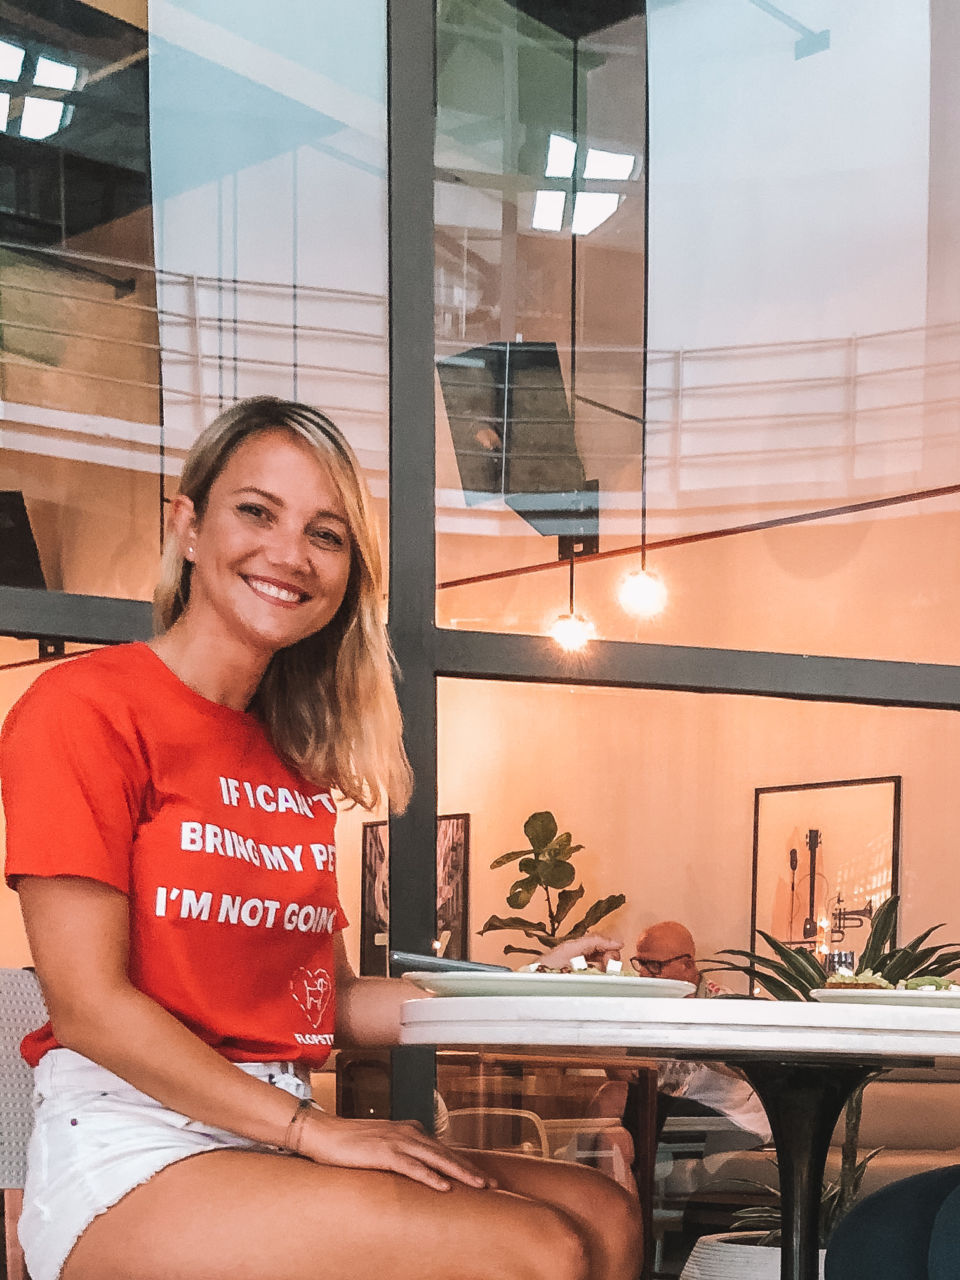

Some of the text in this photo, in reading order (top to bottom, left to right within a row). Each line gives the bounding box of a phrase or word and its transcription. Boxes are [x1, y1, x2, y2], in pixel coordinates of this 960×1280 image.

[219, 776, 240, 807] IF
[243, 782, 255, 808] I
[180, 821, 336, 873] BRING MY PE
[156, 886, 213, 921] I'M
[218, 894, 280, 929] NOT
